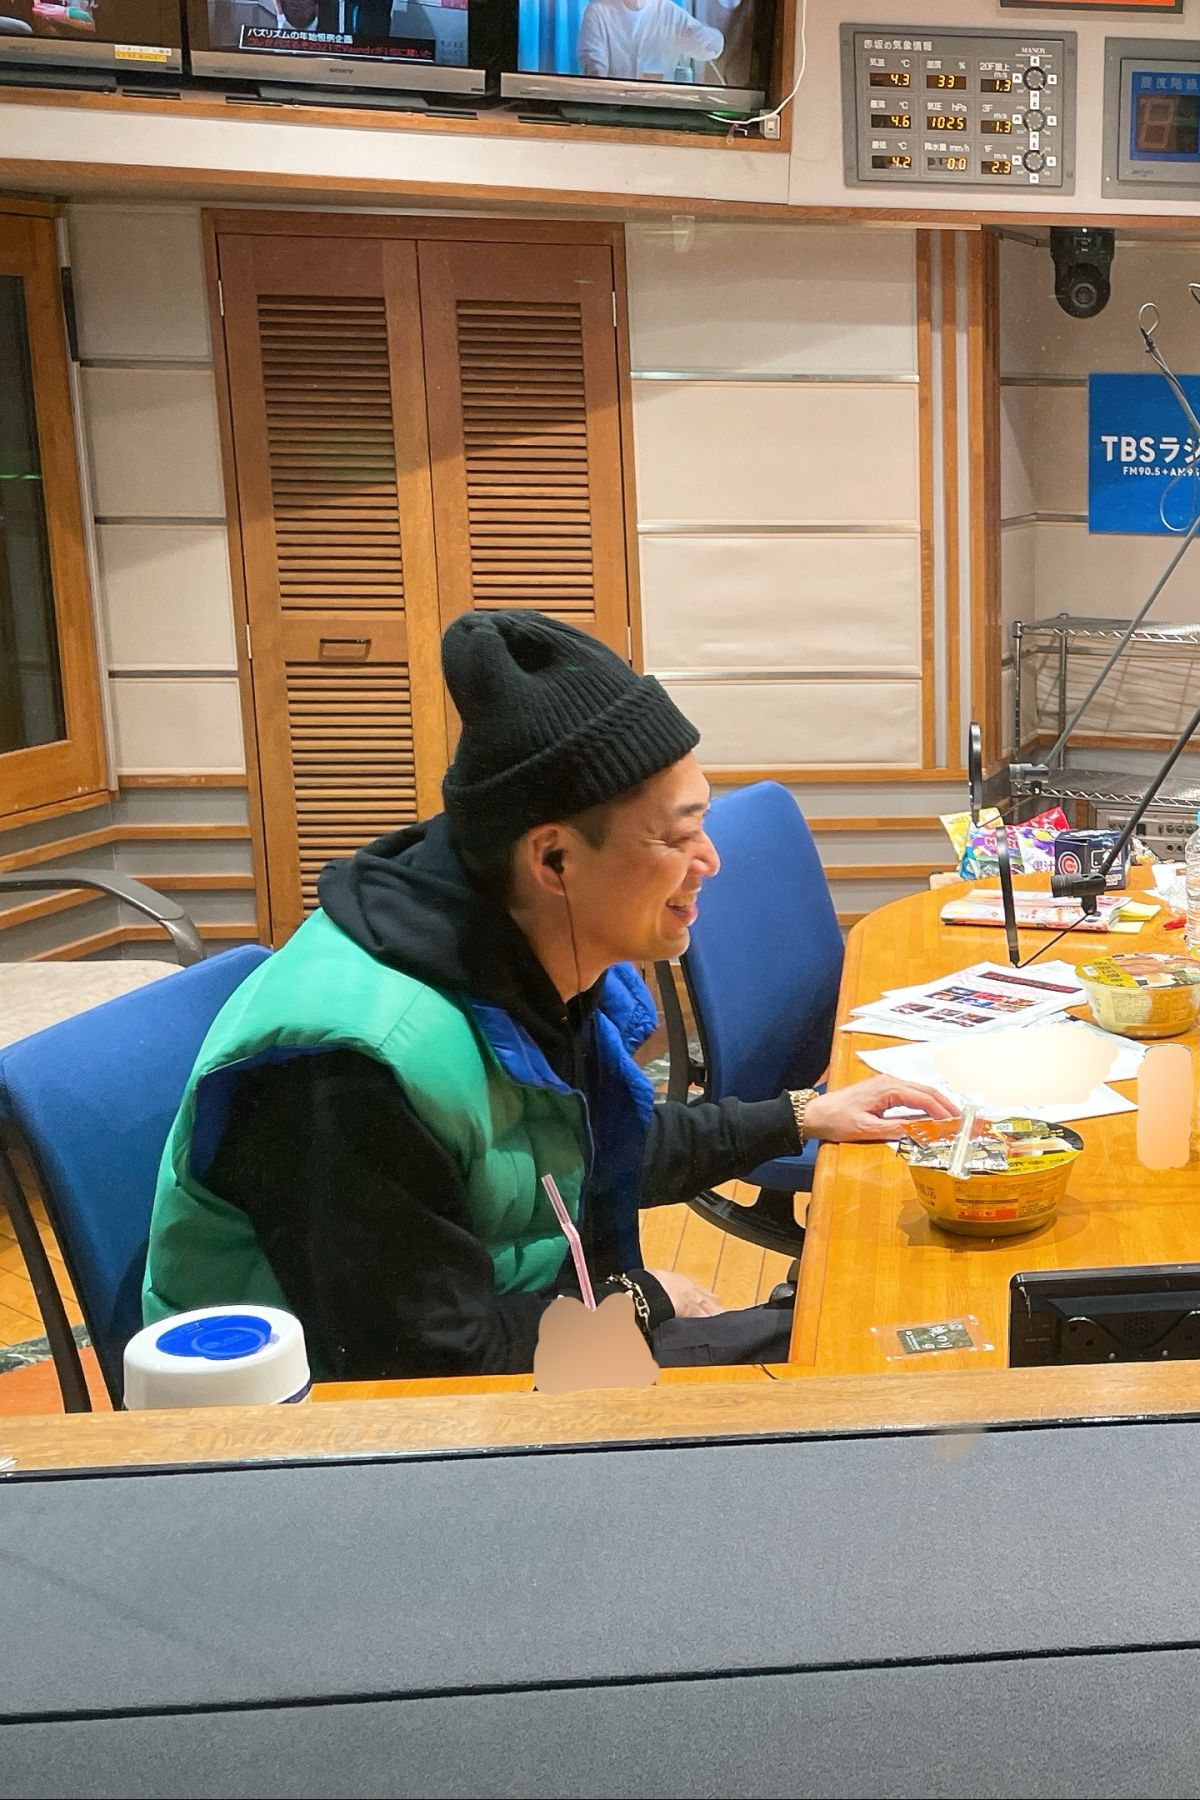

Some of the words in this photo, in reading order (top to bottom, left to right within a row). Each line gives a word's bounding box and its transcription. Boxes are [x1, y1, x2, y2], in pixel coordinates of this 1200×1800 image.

[863, 40, 933, 52] 赤坂の気象情報
[890, 74, 911, 86] 4.3
[937, 75, 955, 88] 33
[994, 79, 1012, 92] 1.3
[951, 103, 968, 112] hPa
[981, 104, 994, 113] 3F
[891, 115, 910, 128] 4.6
[930, 117, 965, 130] 1025
[994, 121, 1012, 133] 1.3
[949, 144, 970, 152] mm/h
[891, 156, 911, 168] 4.2
[991, 161, 1012, 174] 2.3
